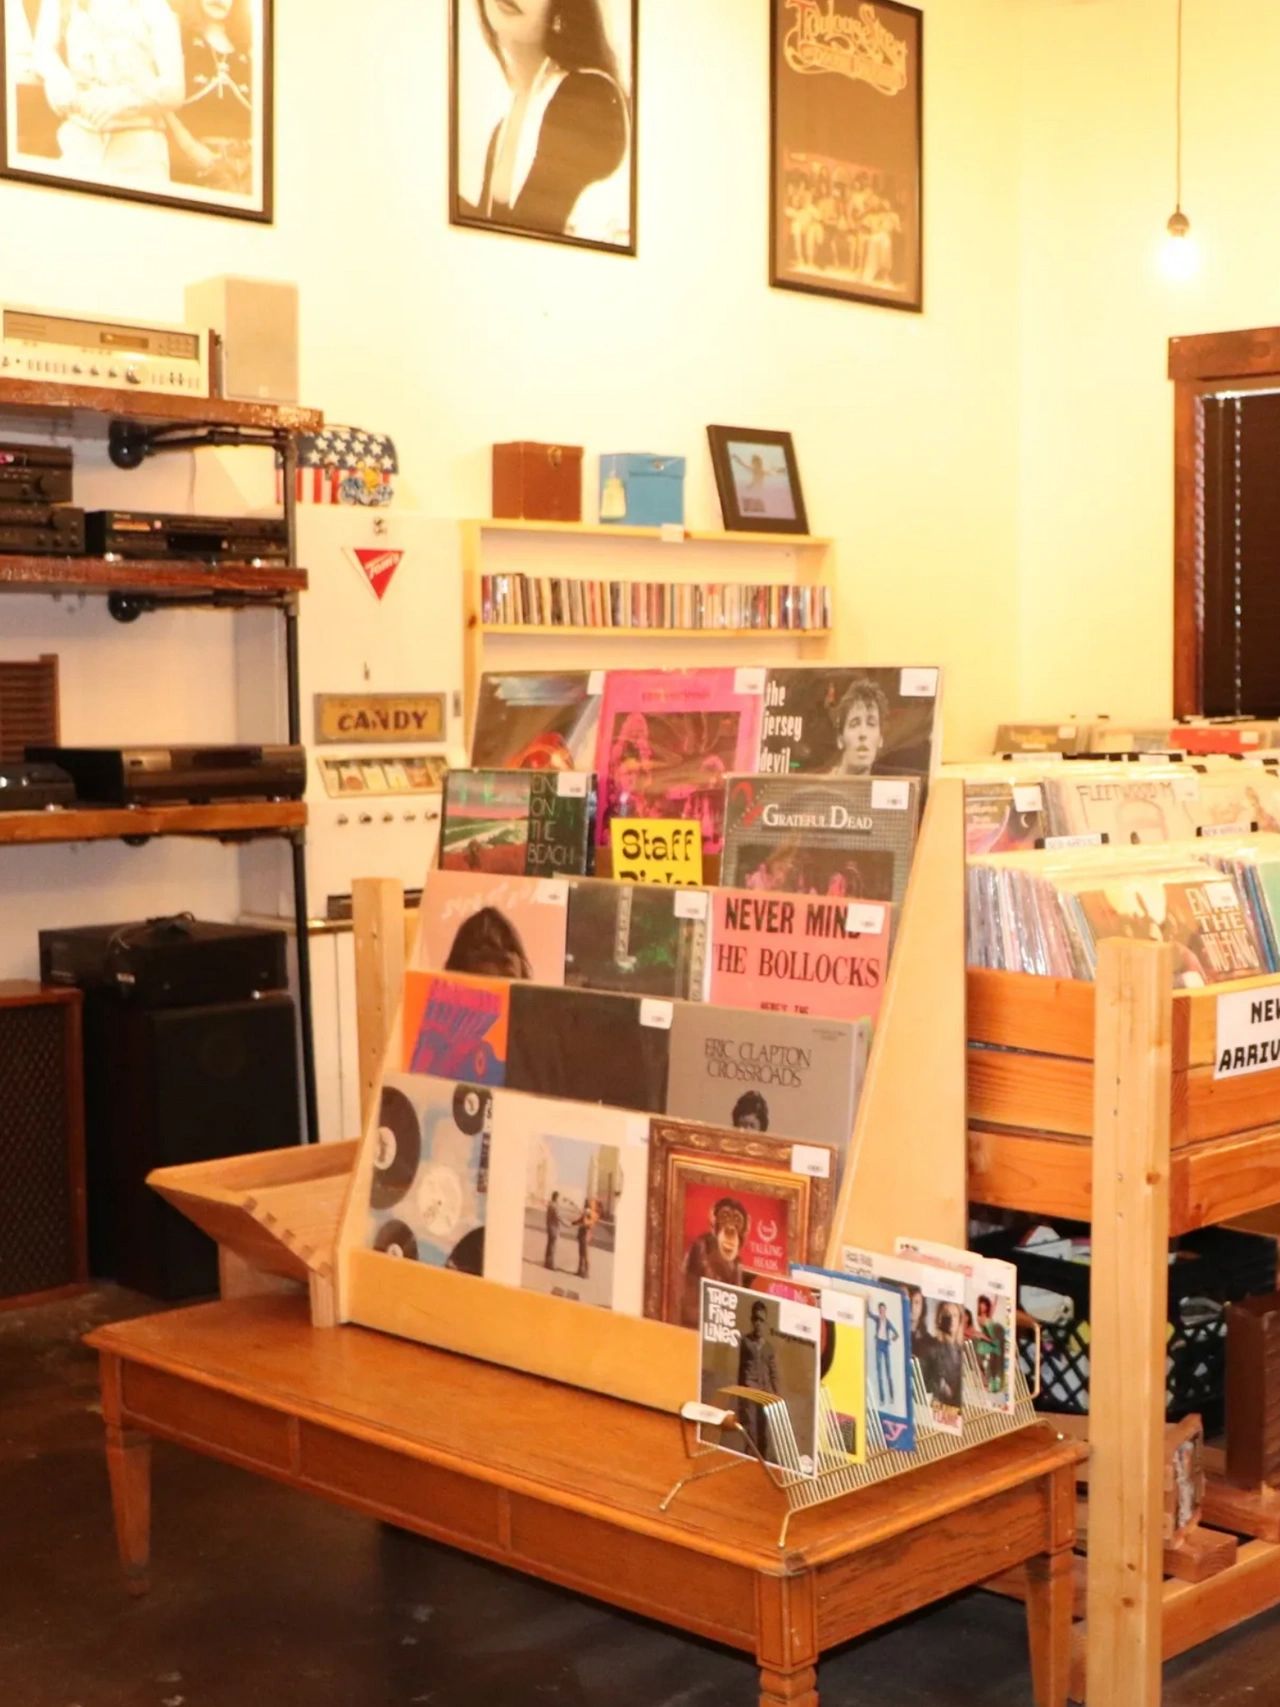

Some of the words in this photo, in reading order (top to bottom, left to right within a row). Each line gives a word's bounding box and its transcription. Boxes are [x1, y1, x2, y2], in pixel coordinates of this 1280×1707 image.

[765, 680, 786, 707] the
[337, 709, 428, 731] CANDY
[762, 711, 803, 741] jersey
[762, 804, 826, 827] GRATEFUL
[830, 805, 873, 830] DEAD
[622, 829, 694, 861] Staff
[725, 898, 795, 934] NEVER
[806, 903, 861, 939] MIN
[1194, 911, 1246, 933] THE
[714, 943, 747, 975] HE
[759, 948, 880, 988] BOLLOCKS
[705, 1038, 735, 1059] ERIC
[739, 1042, 812, 1068] CLAPTON
[706, 1059, 802, 1088] CROSSROADS
